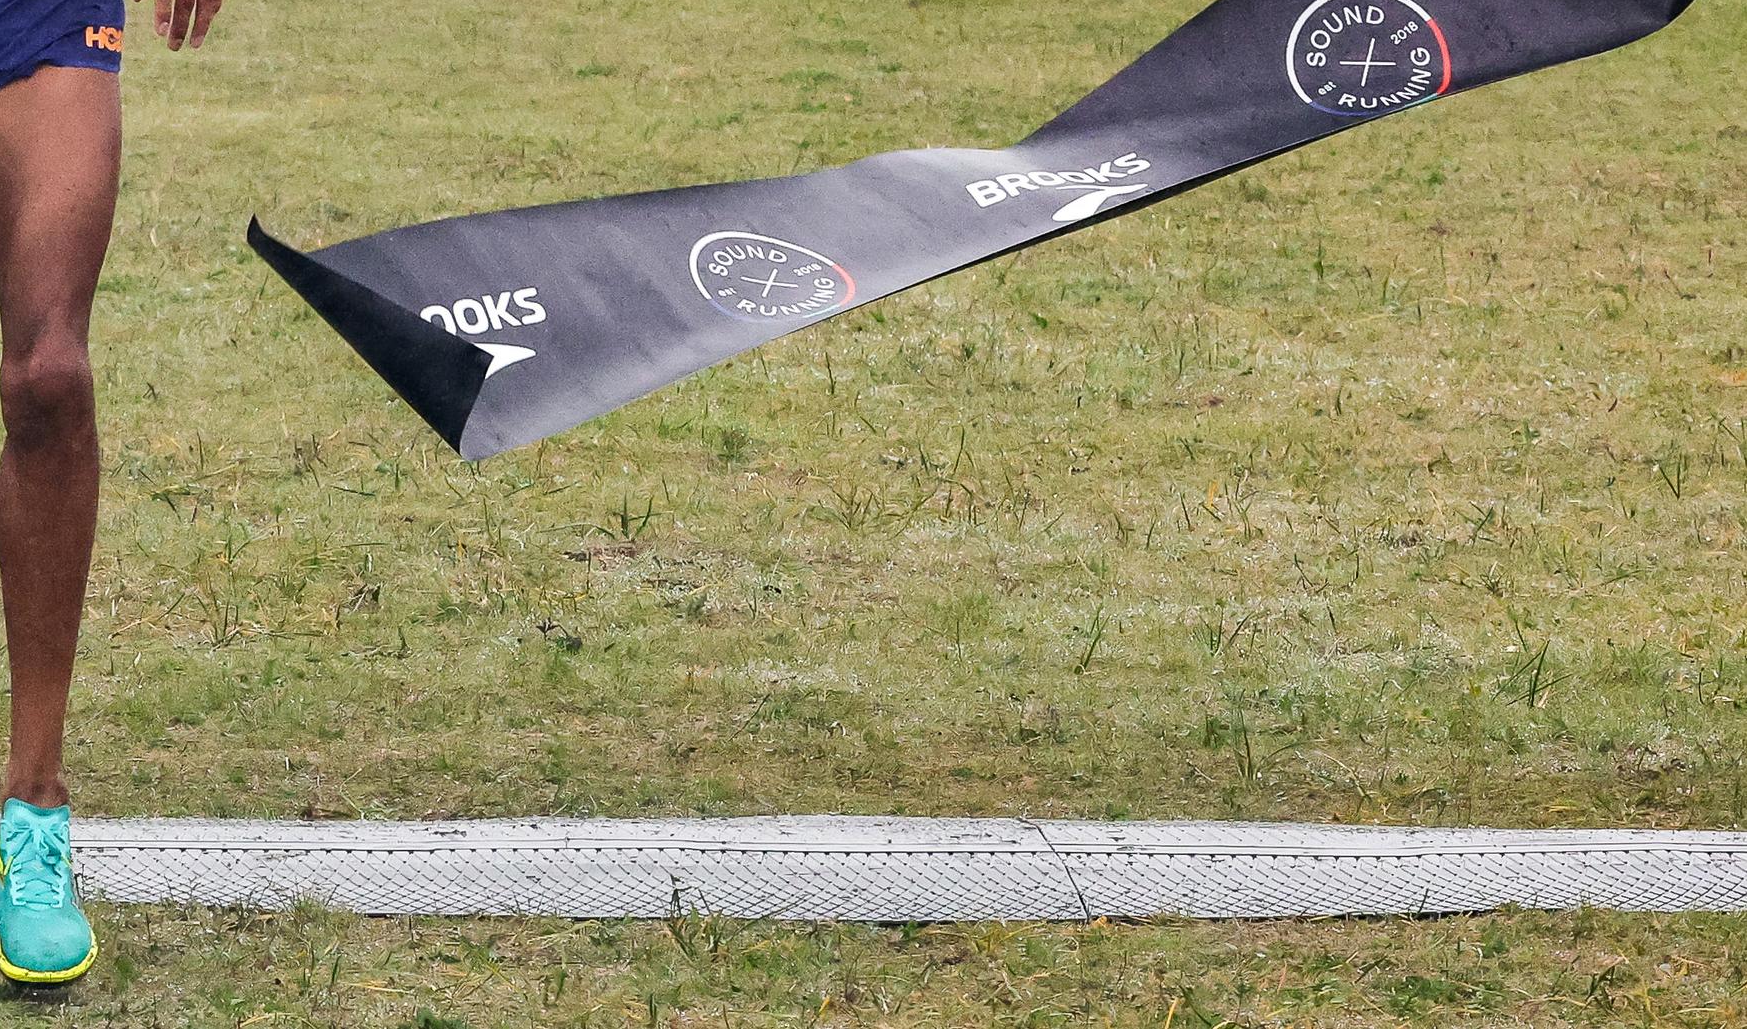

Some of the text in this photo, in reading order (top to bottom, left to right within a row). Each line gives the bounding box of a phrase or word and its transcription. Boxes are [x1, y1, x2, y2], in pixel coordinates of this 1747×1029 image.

[85, 26, 124, 52] HO
[1306, 5, 1384, 67] SOUND
[1317, 21, 1419, 96] est 2018
[1338, 47, 1432, 108] RUNNING
[965, 152, 1151, 208] BROOKS
[709, 245, 788, 277] SOUND
[793, 263, 822, 277] 2018
[736, 277, 836, 317] RUNNING
